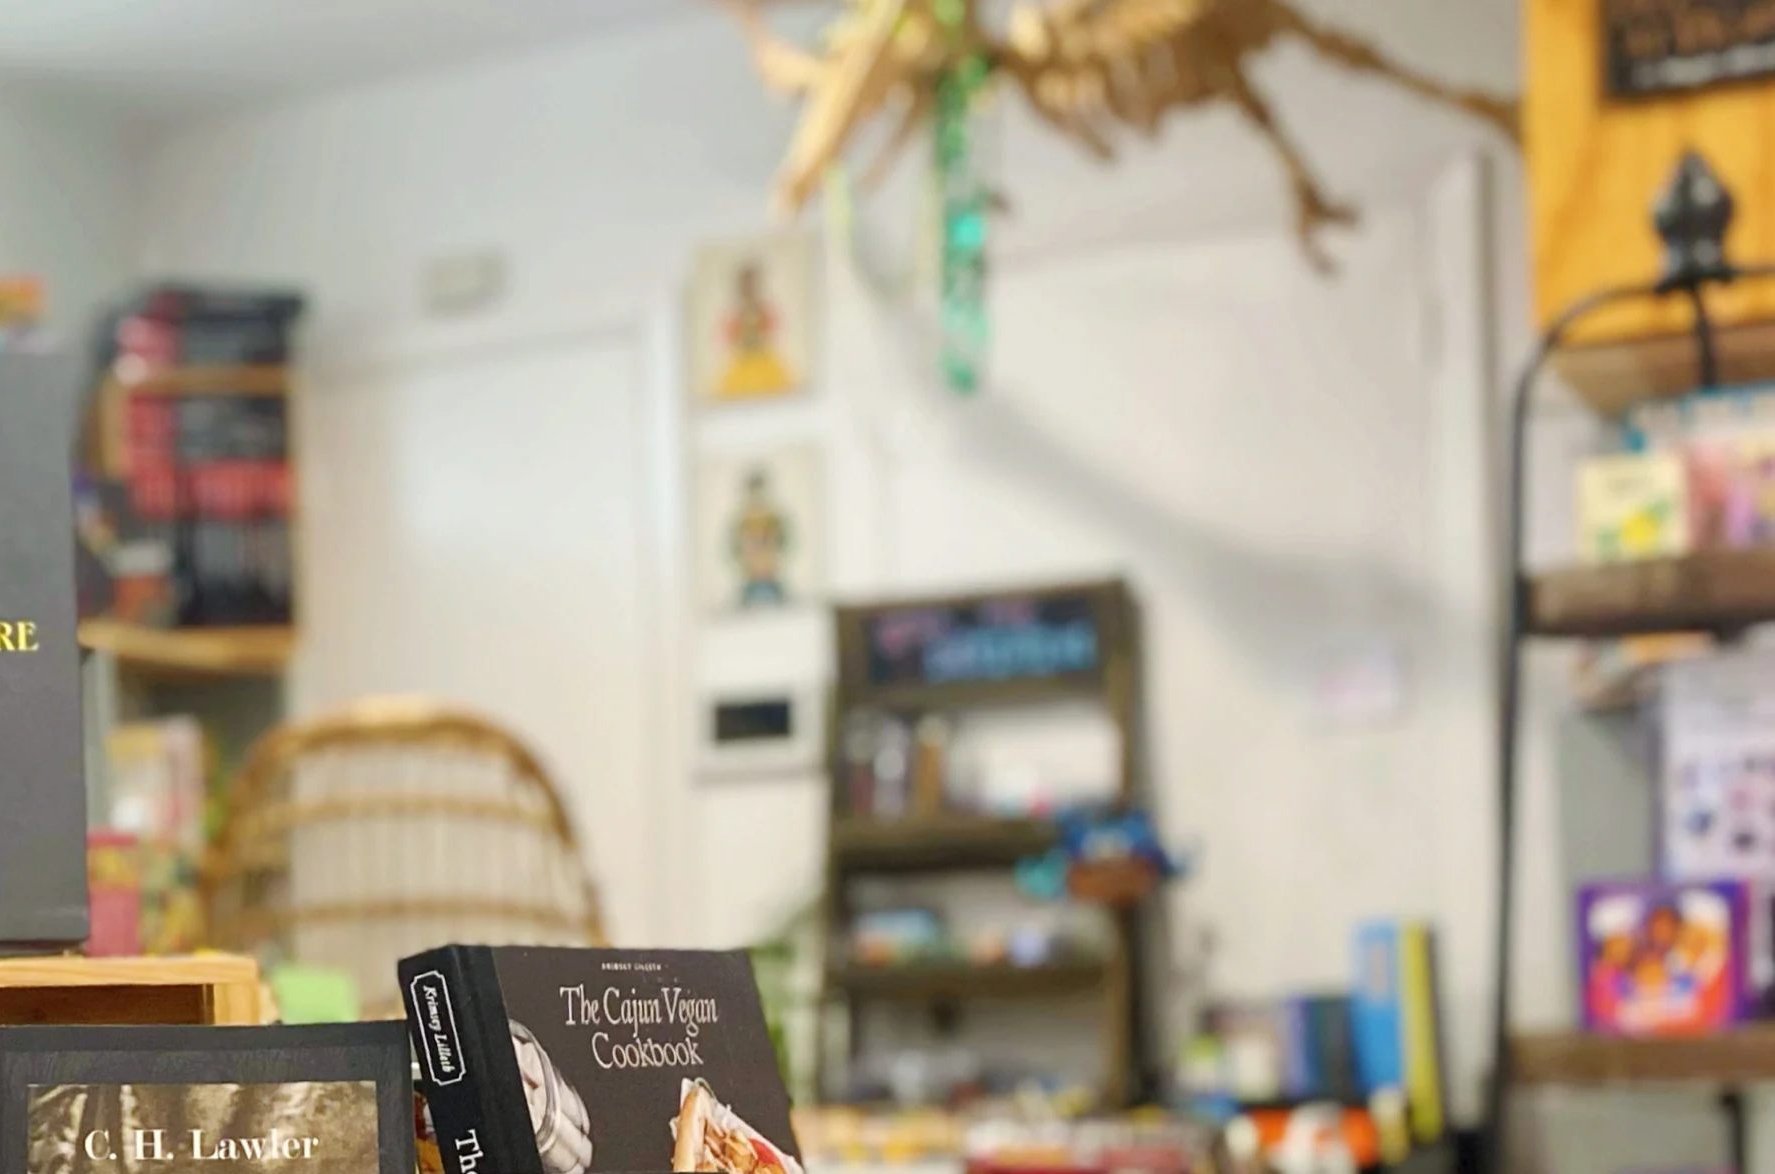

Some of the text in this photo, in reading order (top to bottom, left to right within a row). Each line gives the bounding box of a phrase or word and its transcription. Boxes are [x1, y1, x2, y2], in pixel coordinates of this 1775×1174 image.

[560, 984, 721, 1038] The Cajun Vegan
[591, 1030, 705, 1070] Cookbook
[84, 1127, 320, 1161] C. H. Lawler
